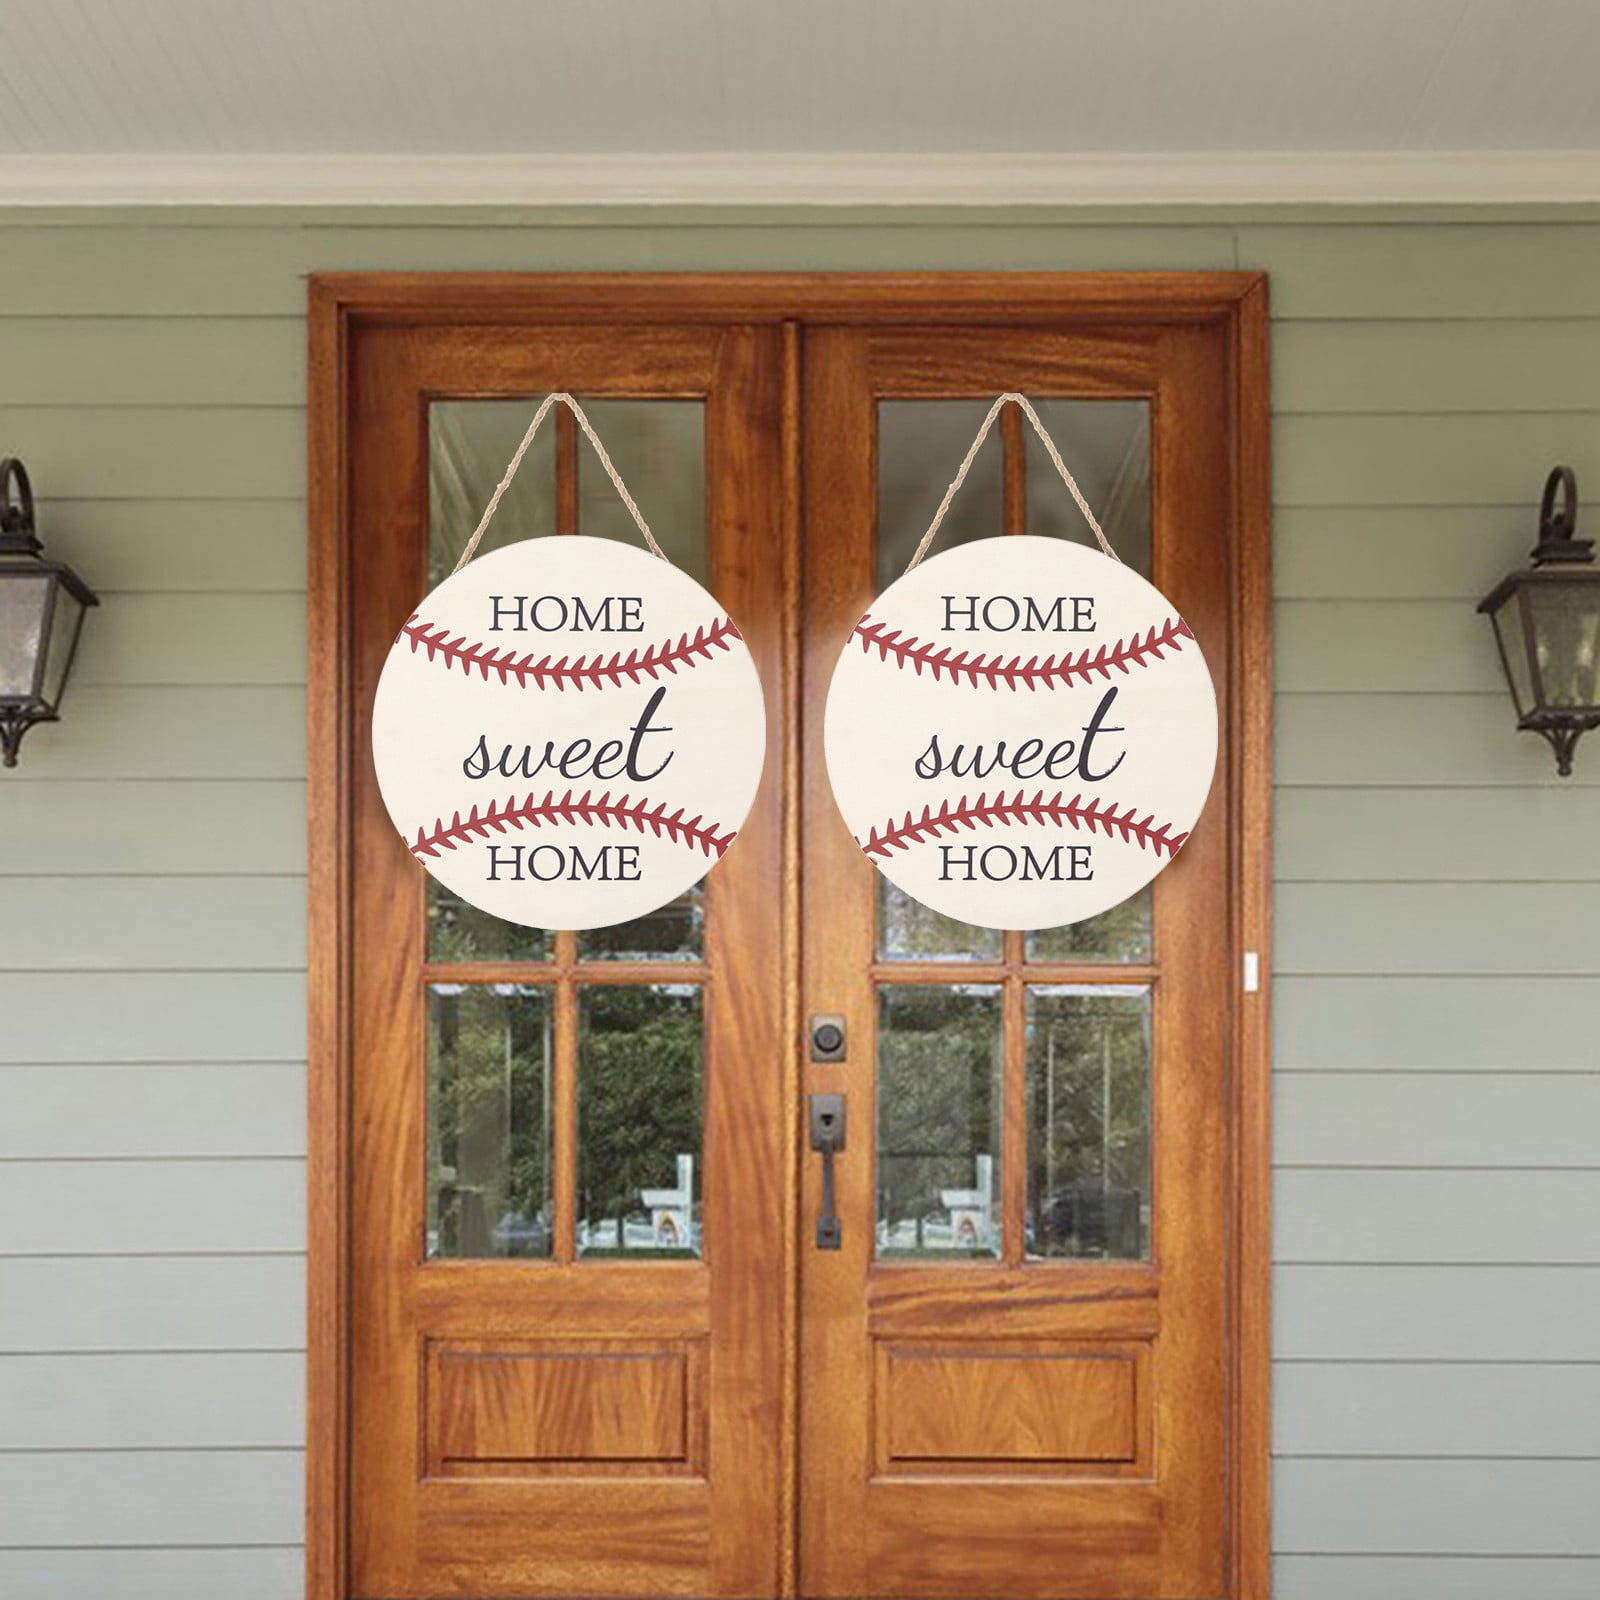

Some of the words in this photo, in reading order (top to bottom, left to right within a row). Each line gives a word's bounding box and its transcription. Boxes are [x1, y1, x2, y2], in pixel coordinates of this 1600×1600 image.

[489, 595, 645, 633] HOME
[941, 595, 1097, 633] HOME
[462, 686, 675, 782] sweet
[914, 686, 1127, 782] sweet
[486, 844, 642, 882] HOME
[938, 844, 1094, 882] HOME
